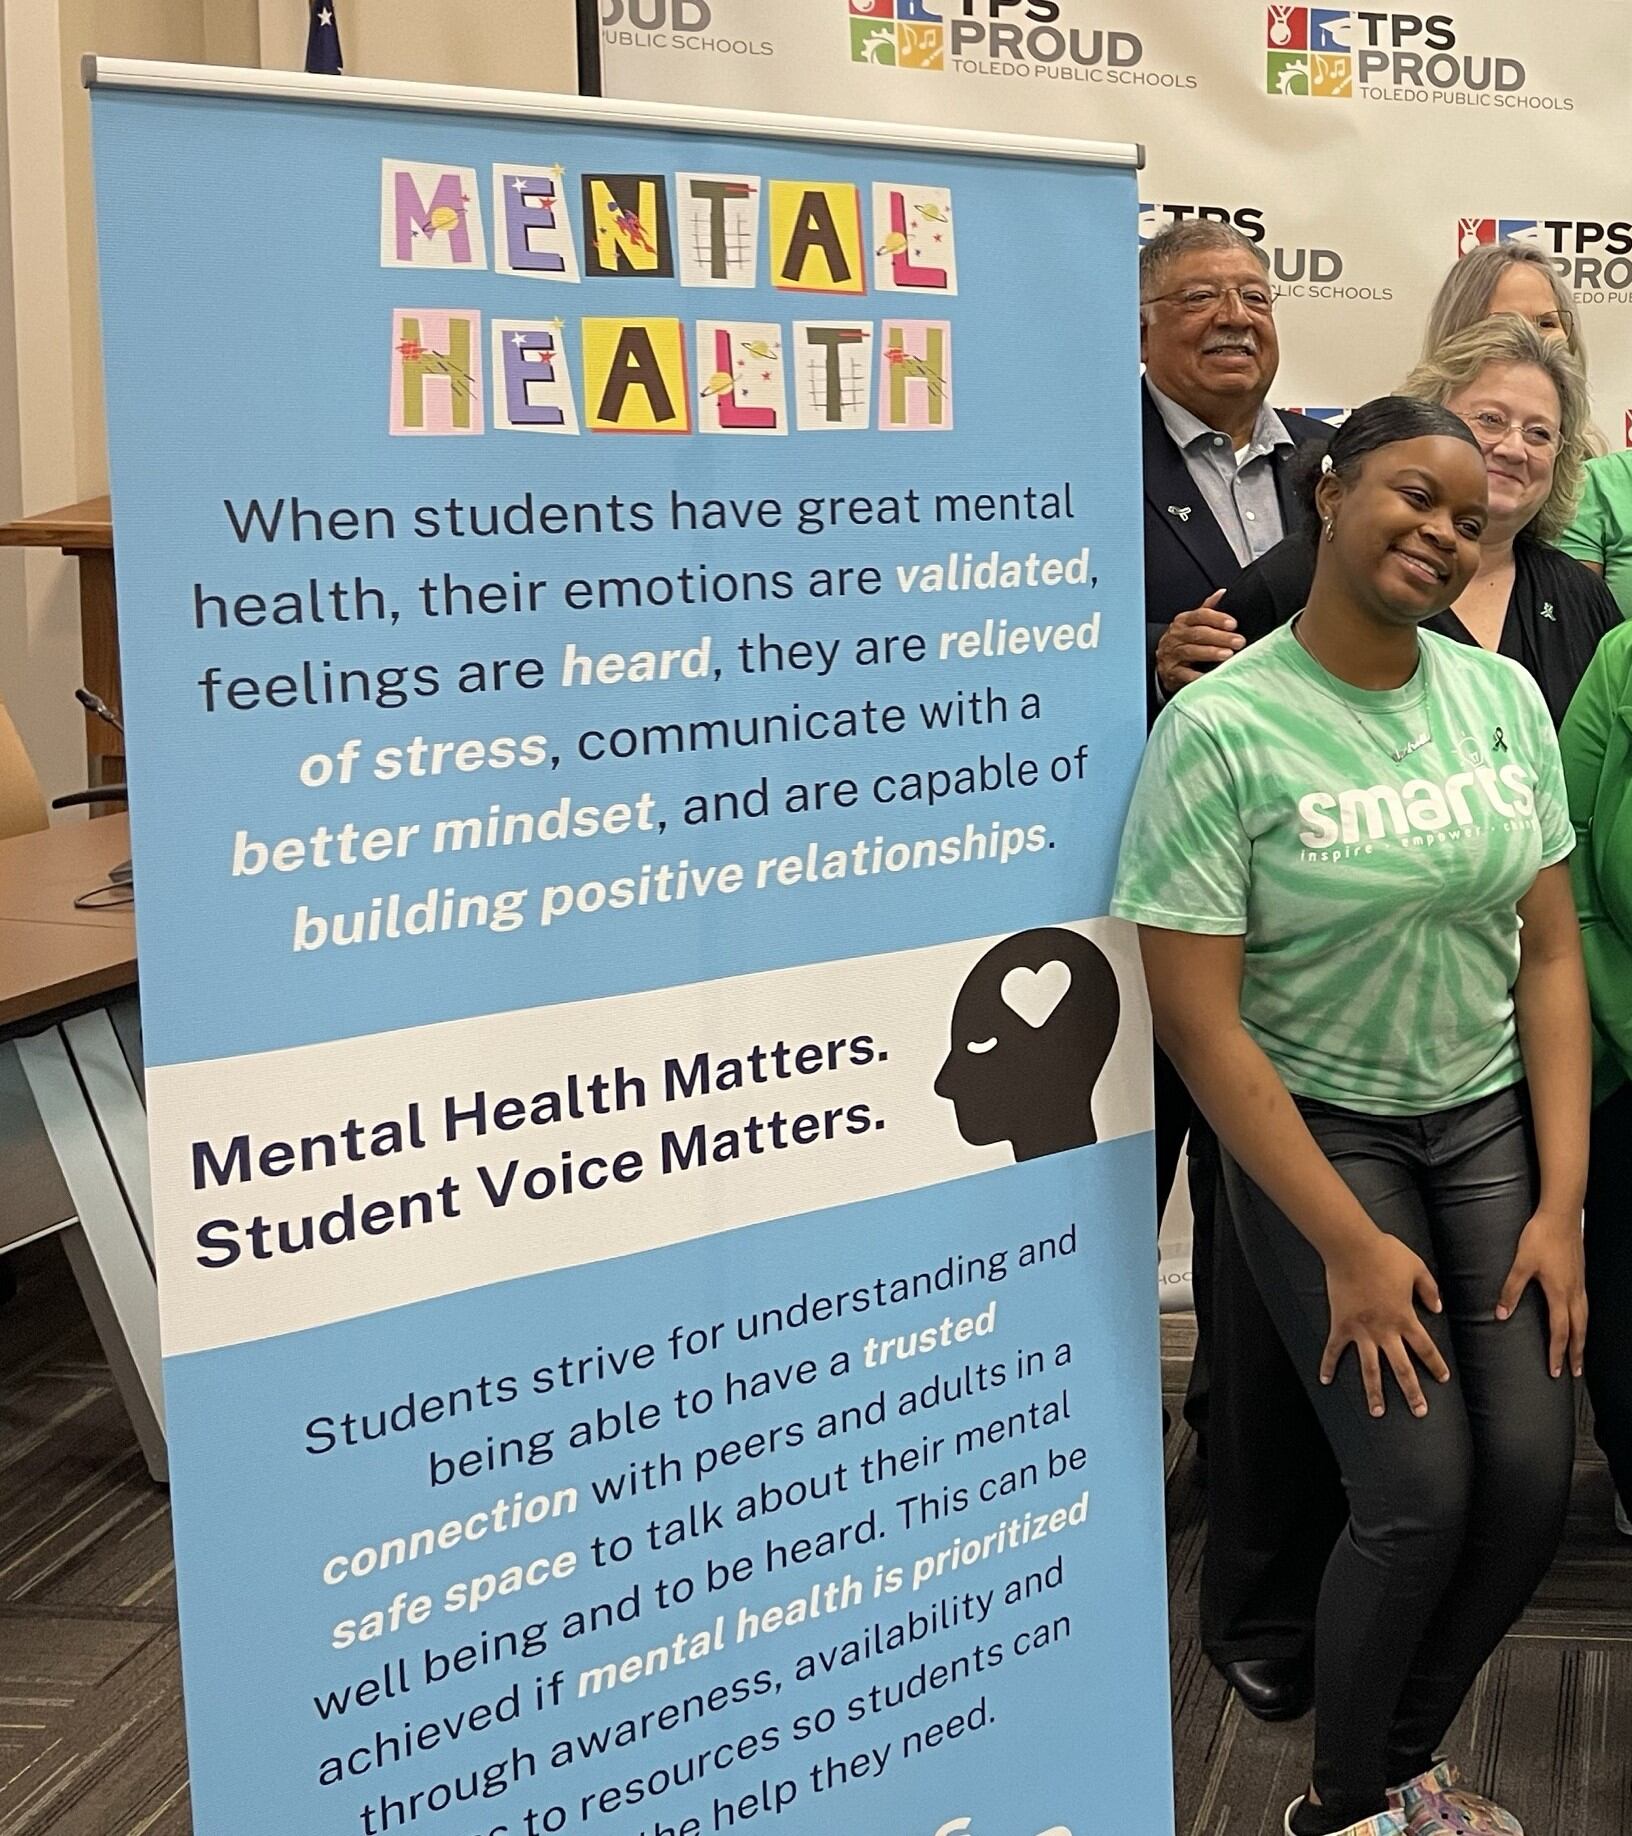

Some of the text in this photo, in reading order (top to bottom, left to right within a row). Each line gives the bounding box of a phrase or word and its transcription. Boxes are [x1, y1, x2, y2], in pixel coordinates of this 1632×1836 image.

[603, 30, 774, 56] UBLIC SCHOOLS
[951, 19, 1143, 67] PROUD
[952, 58, 1197, 89] TOLEDO PUBLIC SCHOOLS
[1357, 12, 1456, 50] TPS
[1358, 49, 1526, 92] PROUD
[1360, 86, 1574, 111] TOLEDO PUBLIC SCHOOLS
[391, 169, 952, 292] MENTAL
[1309, 286, 1393, 301] SCHOOLS
[395, 315, 949, 431] HEALTH
[223, 481, 1075, 544] When students have great mental
[193, 547, 1098, 629] health, their emotions are validated,
[197, 612, 1101, 713] feelings are heard, they are relieved
[300, 686, 1041, 787] of stress, communicate with a
[232, 744, 1089, 876] better mindset, and are capable of
[1298, 764, 1536, 849] smarts
[1300, 826, 1481, 863] inspire empower
[293, 821, 1055, 952] building positive relationships.
[192, 1035, 888, 1190] Mental Health Matters.
[196, 1104, 885, 1269] Student Voice Matters.
[305, 1222, 1077, 1455] Students strive for understanding and
[429, 1301, 996, 1488] being able to have a trusted
[323, 1343, 1071, 1585] connection with peers and adults in a
[332, 1388, 1071, 1649] safe space to talk about their mental
[313, 1447, 1087, 1721] well being and to be heard. This can be
[319, 1491, 1089, 1786] achieved if mental health is prioritized
[359, 1554, 1063, 1836] through awareness, availability and
[522, 1616, 1070, 1836] to resources so students can
[713, 1695, 997, 1832] help they need.
